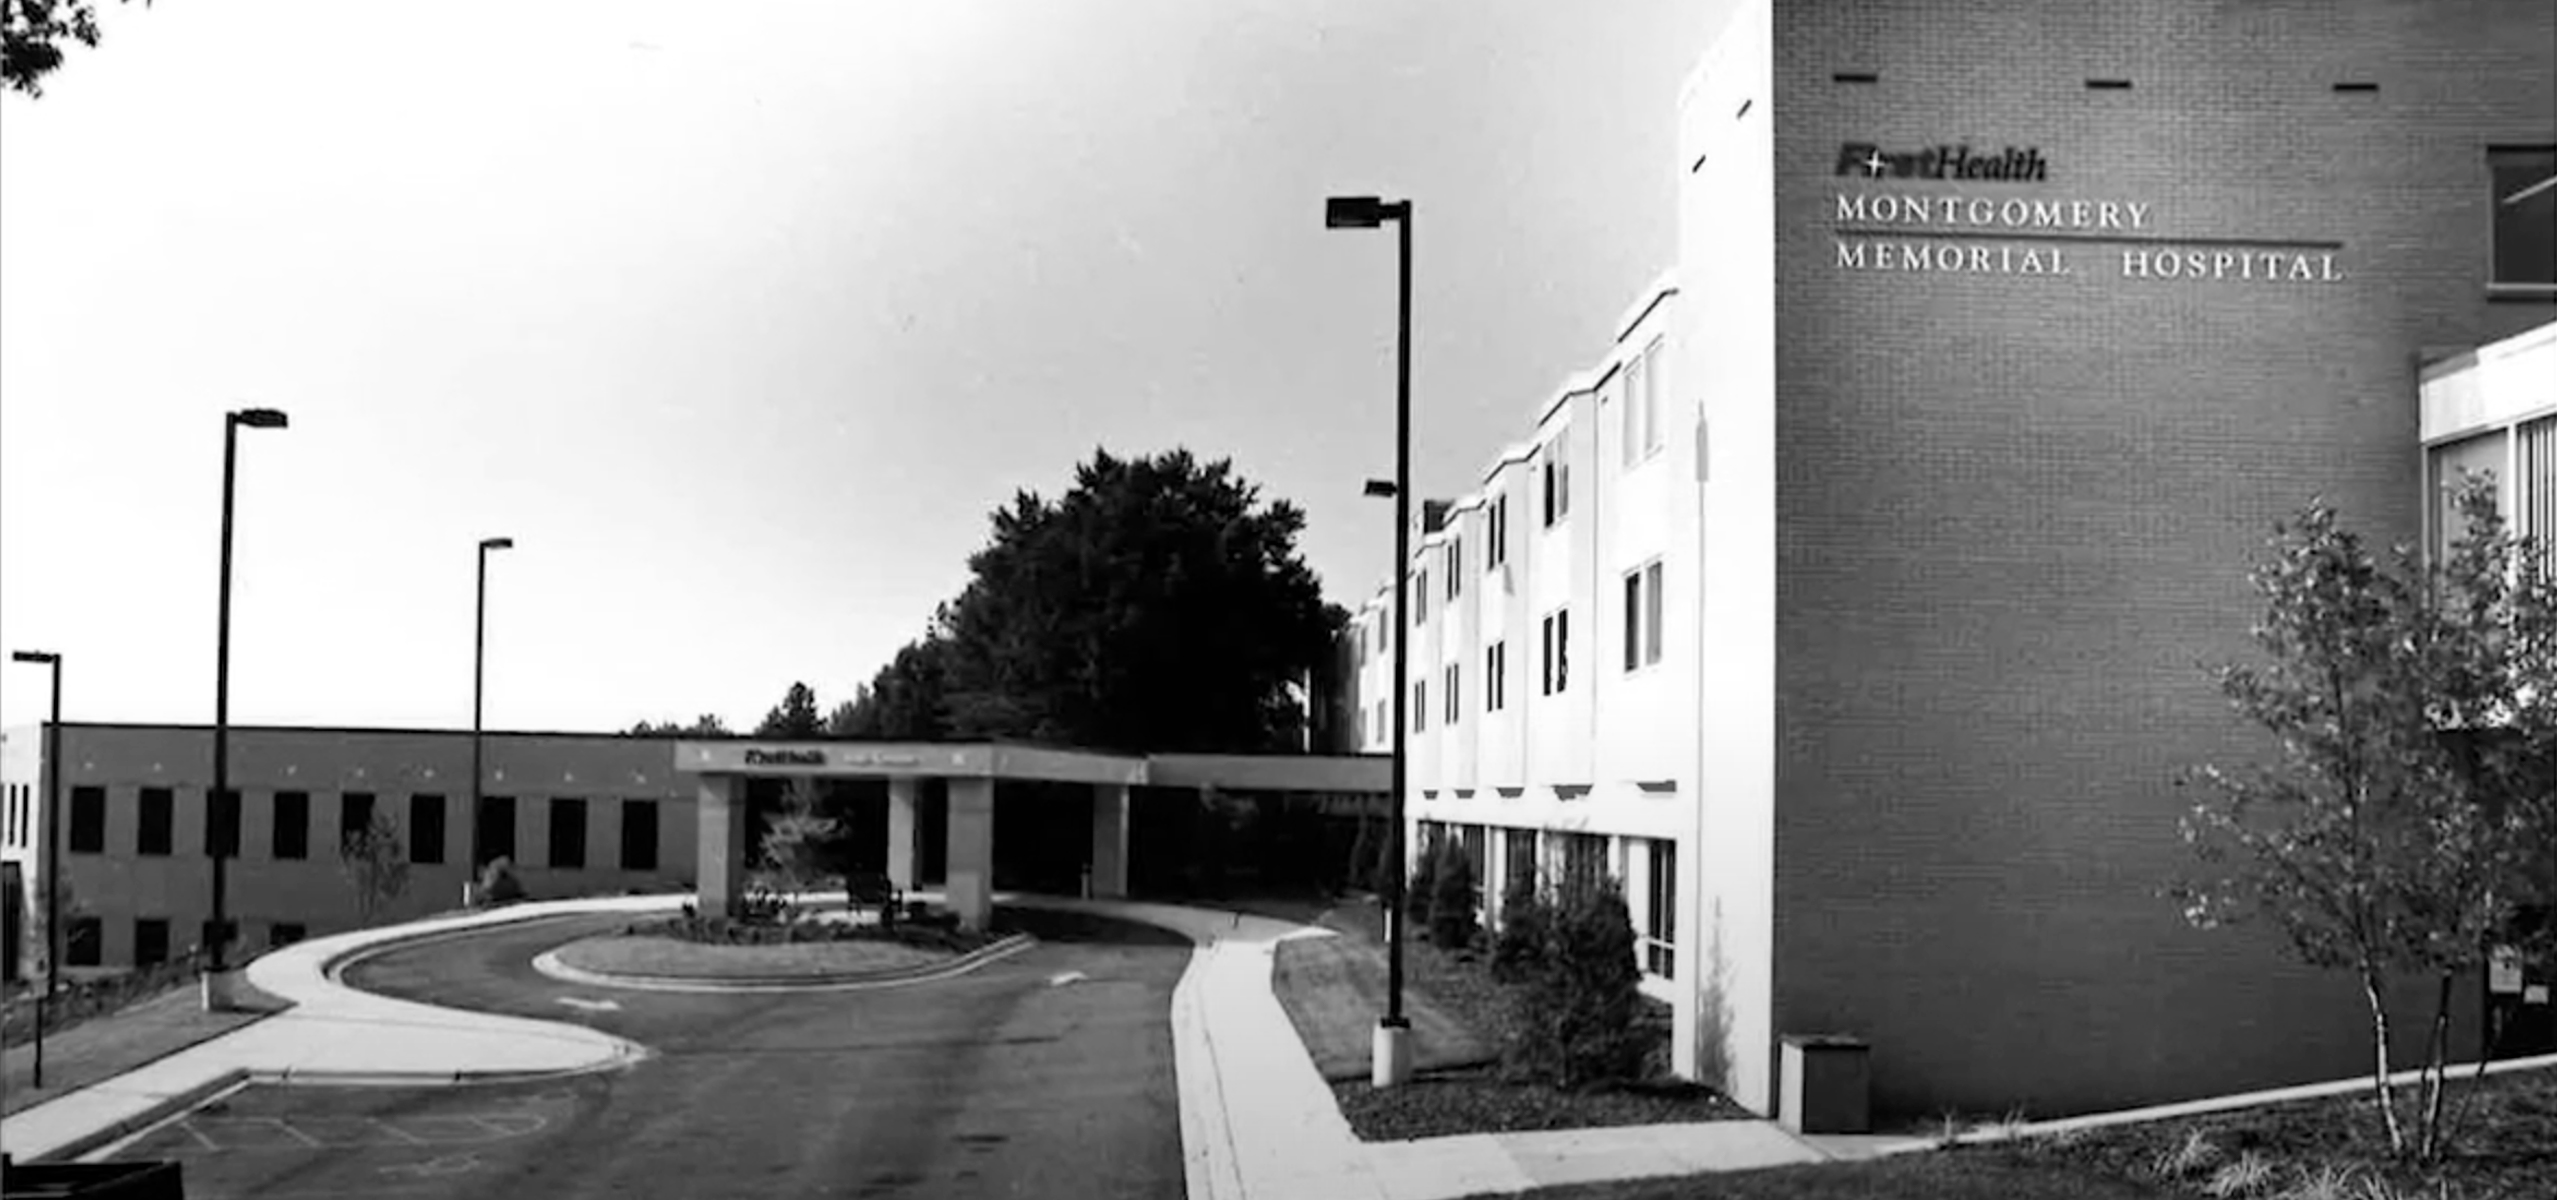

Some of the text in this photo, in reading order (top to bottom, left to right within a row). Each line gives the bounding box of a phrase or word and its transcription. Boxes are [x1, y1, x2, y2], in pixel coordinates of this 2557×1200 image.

[1837, 195, 2151, 229] MONTGOMERY
[1837, 243, 2343, 281] MEMORIAL HOSPITAL
